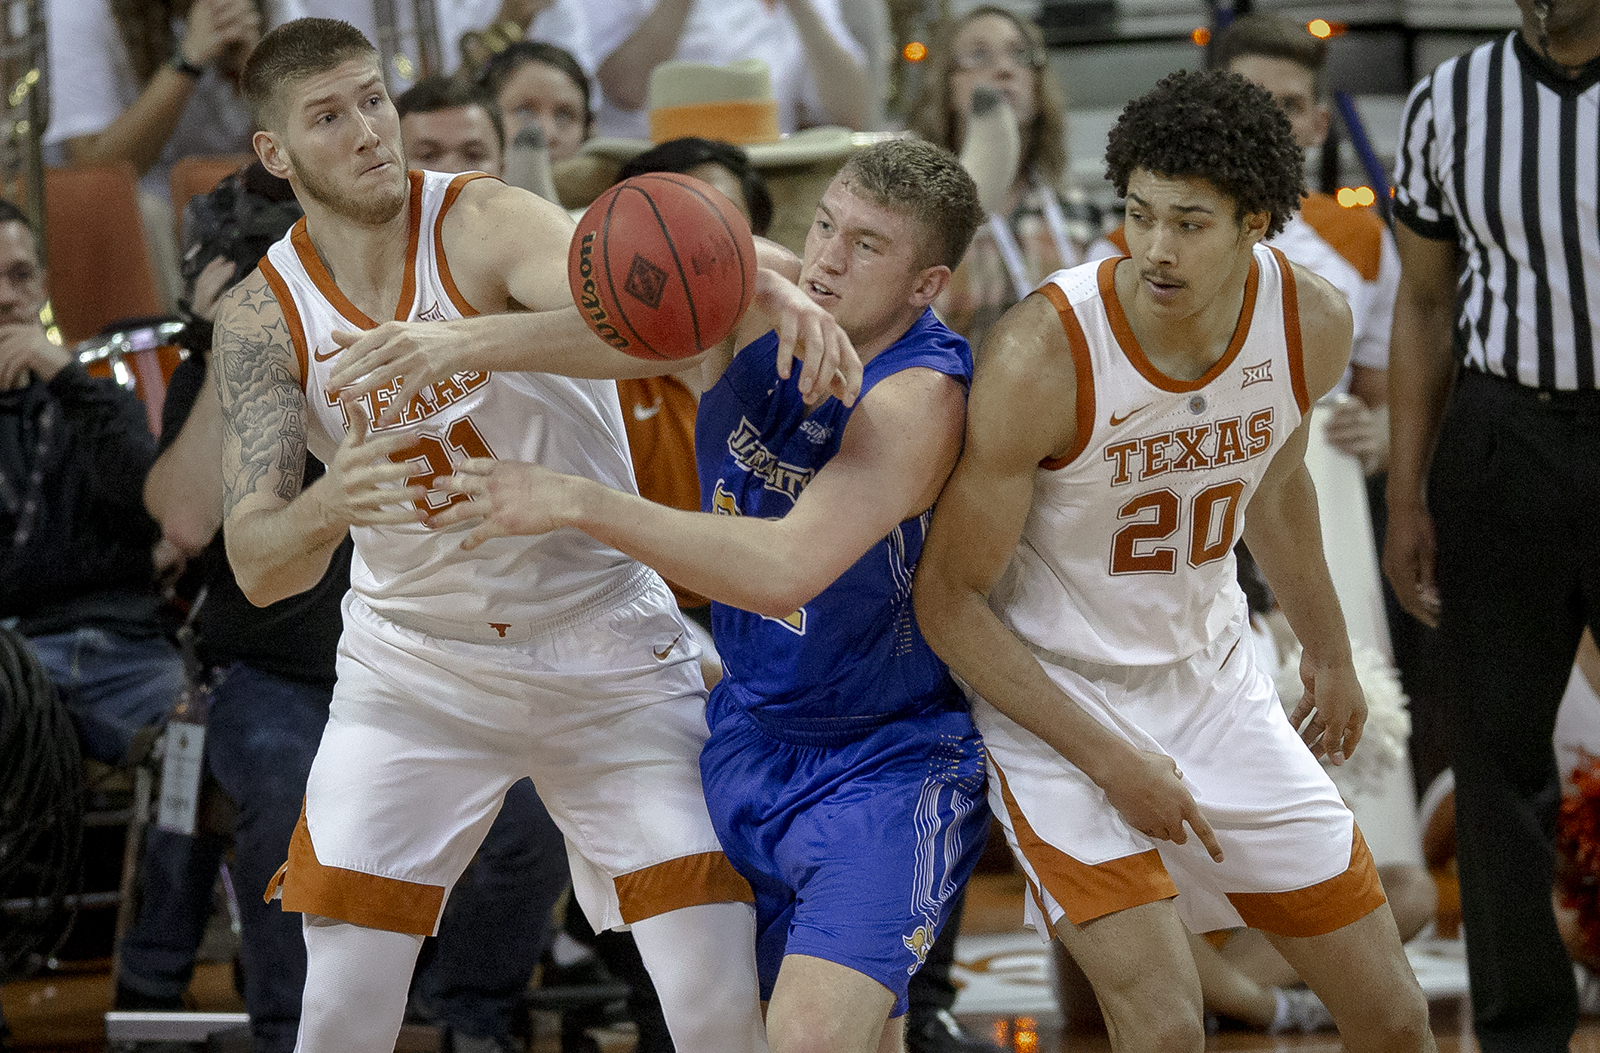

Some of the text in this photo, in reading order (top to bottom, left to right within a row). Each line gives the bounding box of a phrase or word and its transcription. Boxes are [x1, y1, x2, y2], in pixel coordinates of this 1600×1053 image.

[579, 230, 630, 349] Wilson
[1104, 406, 1274, 488] TEXAS
[1109, 477, 1248, 577] 20
